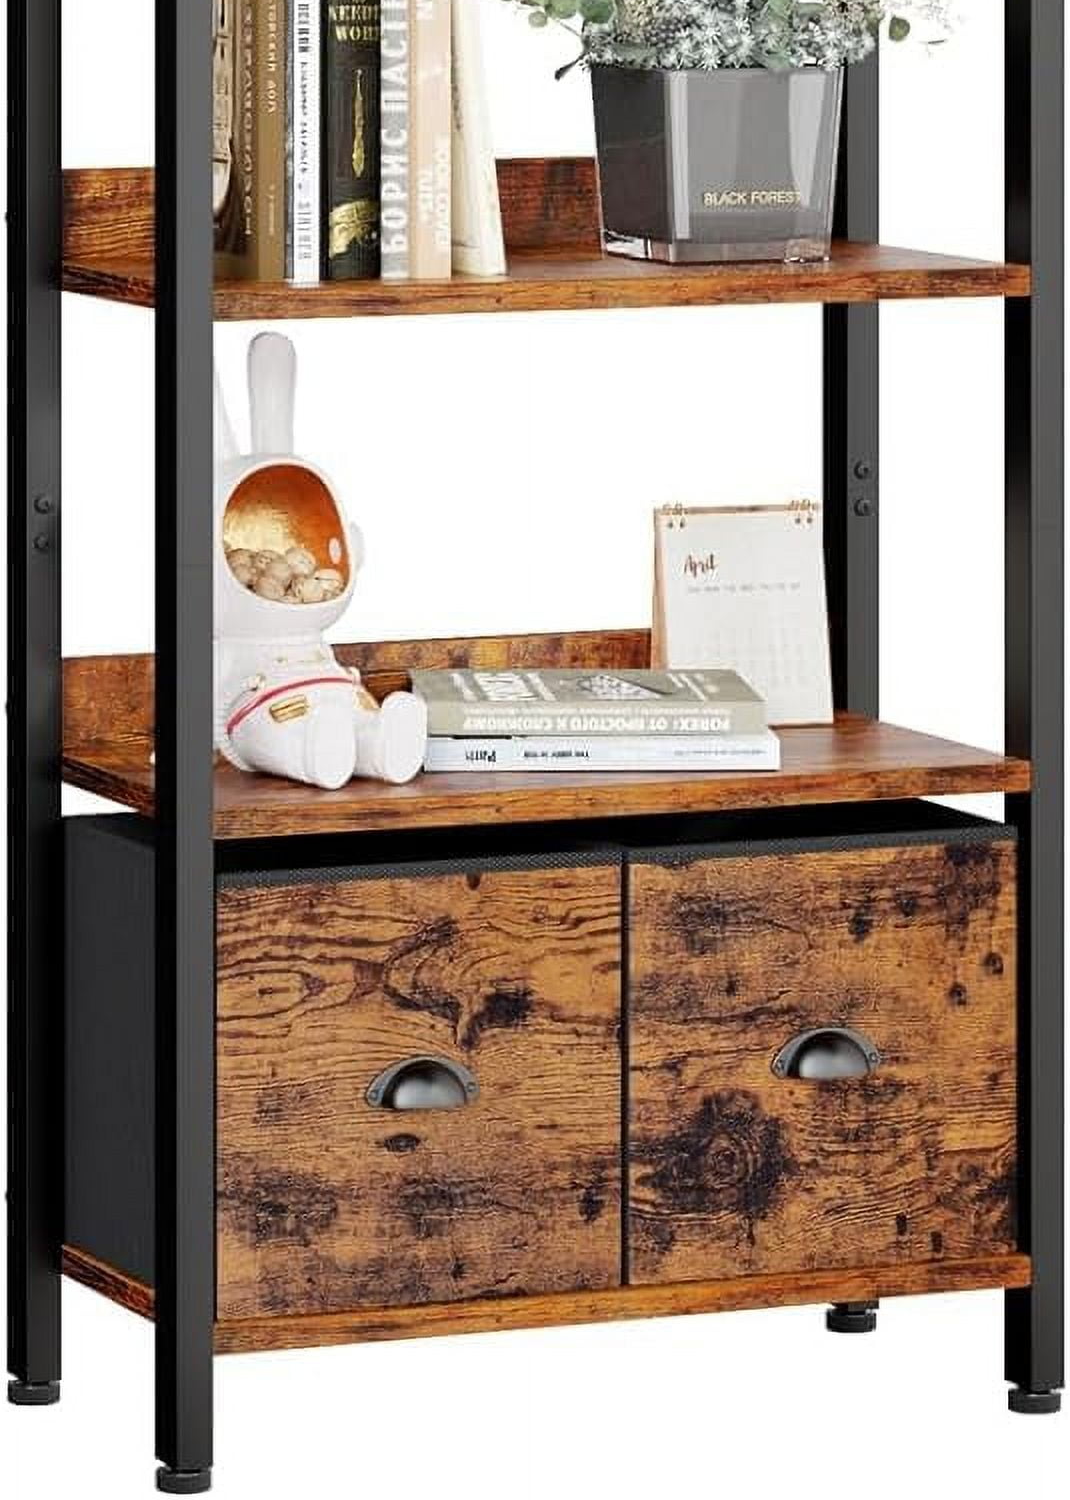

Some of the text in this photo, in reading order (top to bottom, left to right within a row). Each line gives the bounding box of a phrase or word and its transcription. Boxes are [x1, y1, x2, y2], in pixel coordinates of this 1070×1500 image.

[703, 190, 801, 207] BLACK FOREST
[684, 553, 718, 578] April
